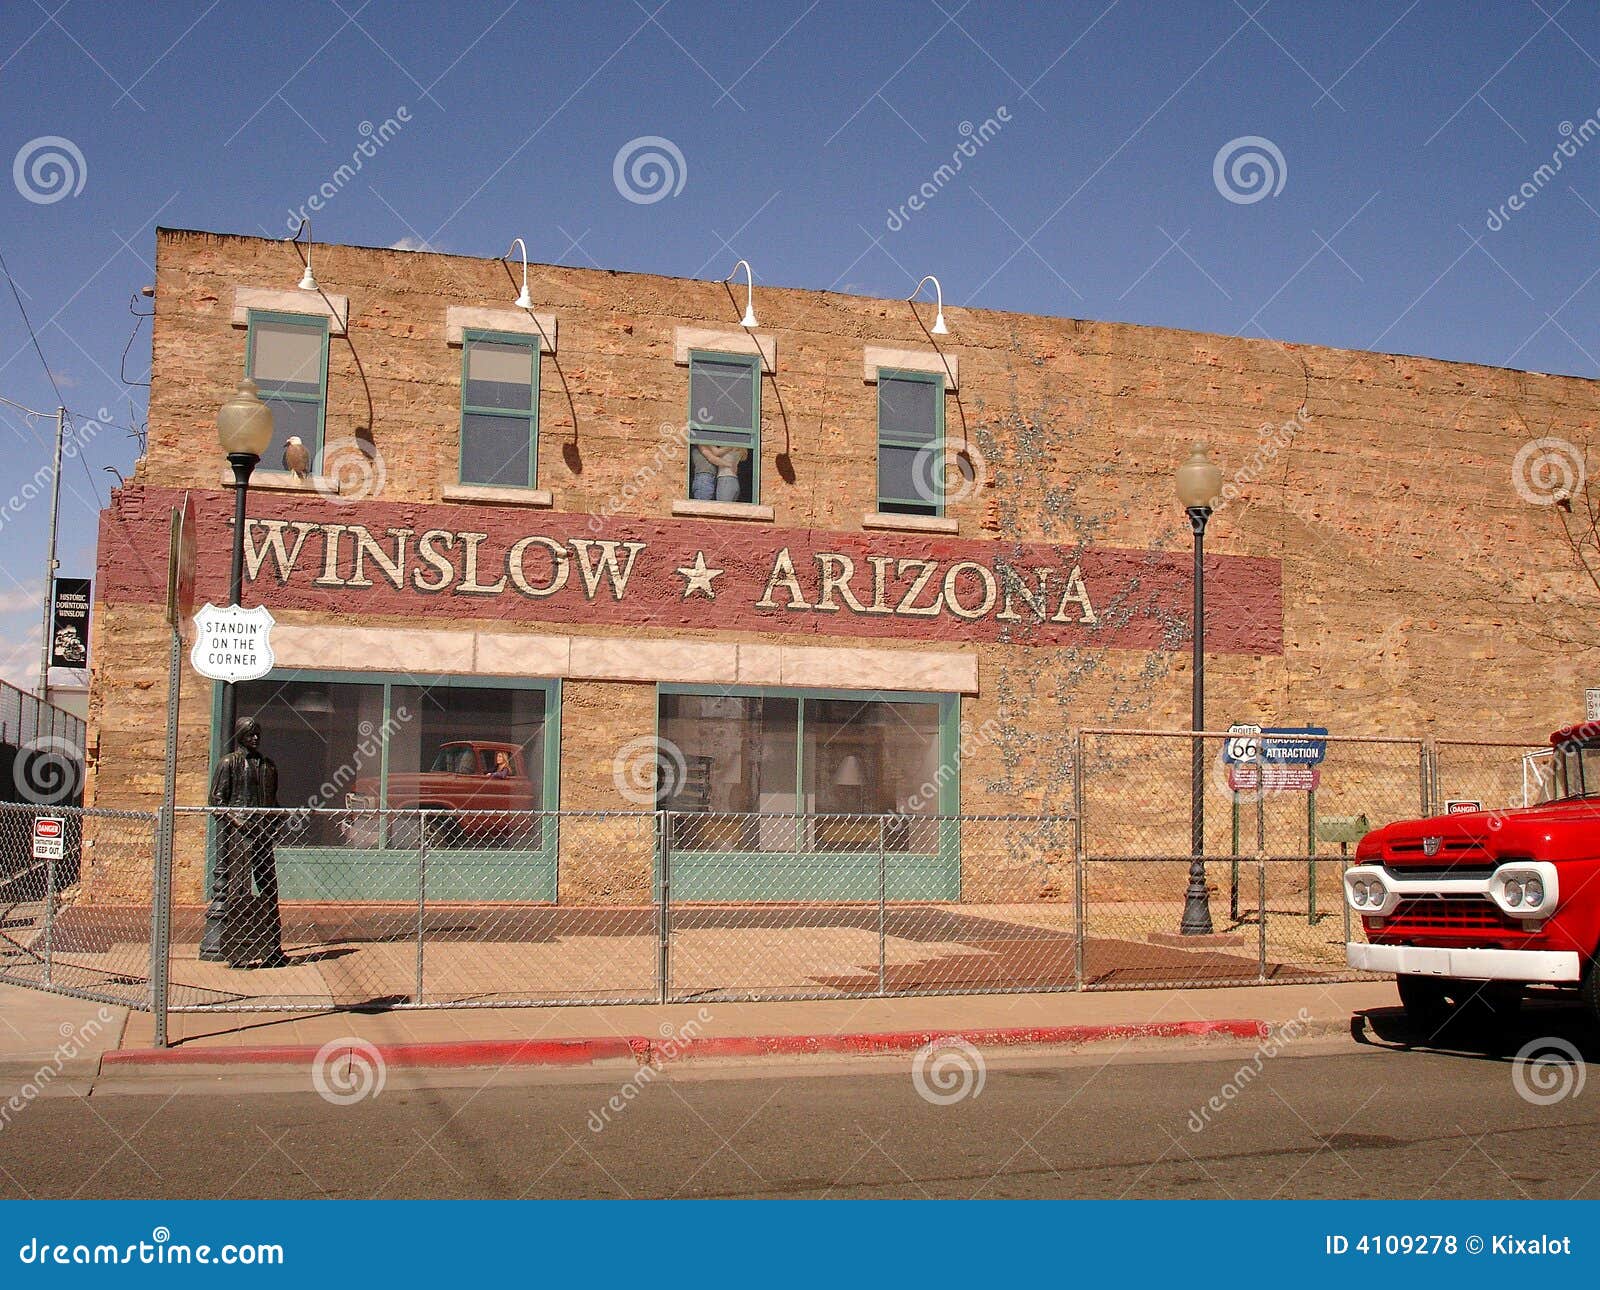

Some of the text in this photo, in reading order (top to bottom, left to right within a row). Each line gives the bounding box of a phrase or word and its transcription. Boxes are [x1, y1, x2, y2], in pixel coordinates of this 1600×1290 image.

[230, 517, 1100, 624] WINSLOW ARIZONA
[59, 593, 86, 602] HISTORIC
[56, 601, 88, 610] DOWNTOWN
[59, 610, 85, 618] WINSLOW
[212, 638, 255, 650] ON THE
[208, 653, 257, 665] CORNER
[1232, 727, 1257, 735] ROUTE
[1232, 737, 1257, 757] 66
[1266, 748, 1319, 759] ATTRACTION
[38, 825, 59, 833] DANGER
[36, 846, 59, 855] KEEP OUT
